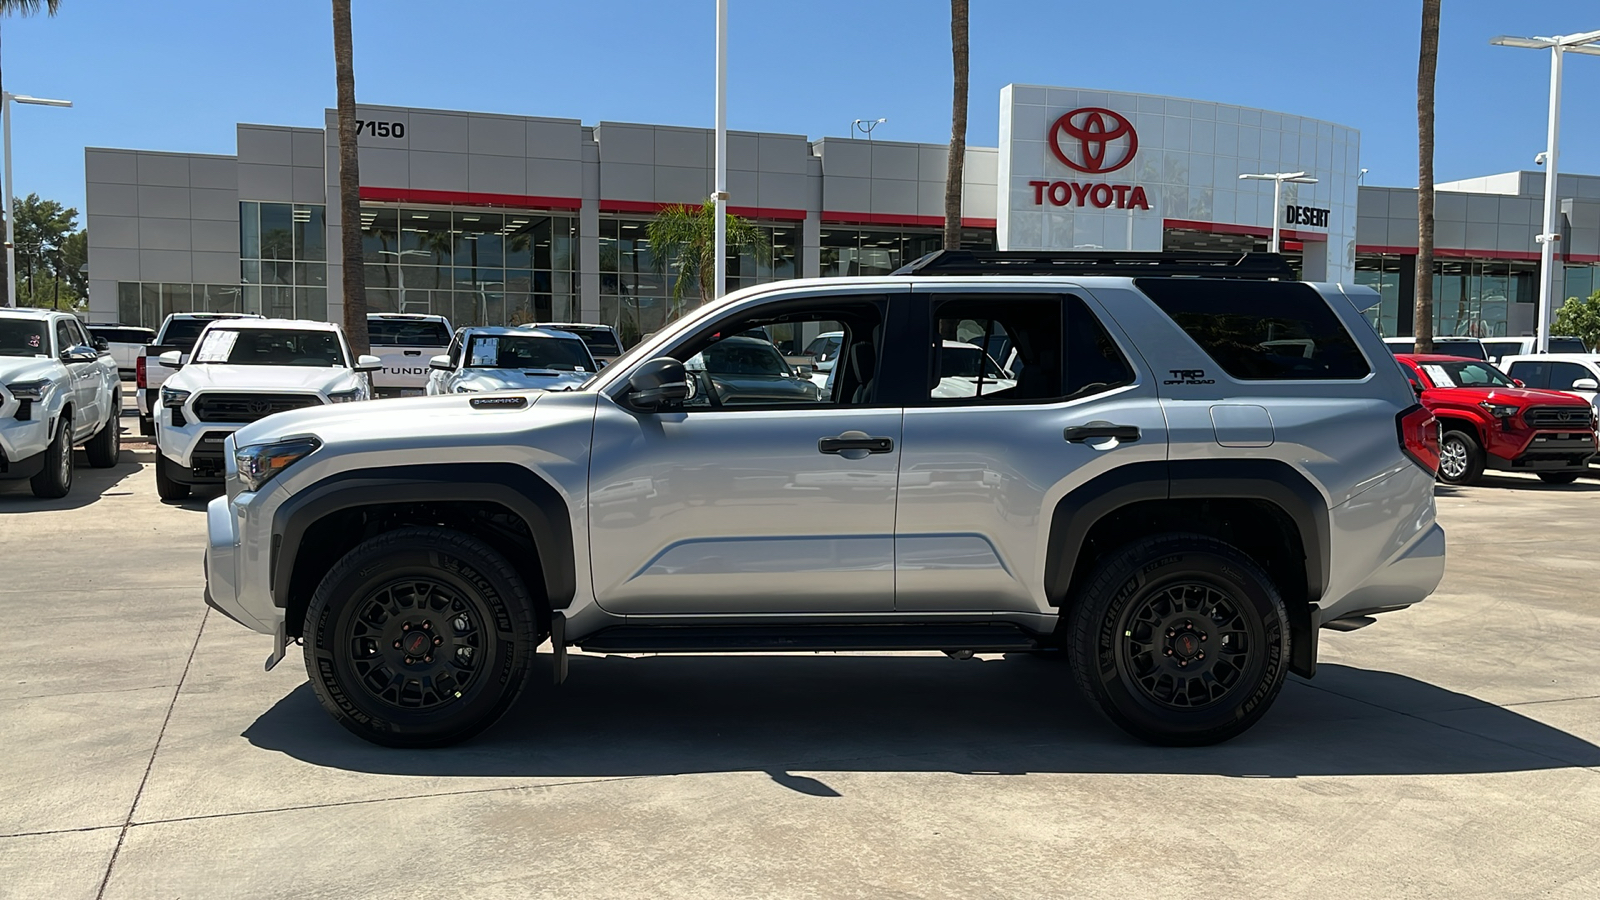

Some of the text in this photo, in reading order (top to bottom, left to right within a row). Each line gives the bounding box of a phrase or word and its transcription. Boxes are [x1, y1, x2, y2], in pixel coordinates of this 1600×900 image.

[355, 120, 405, 138] 7150
[1029, 181, 1150, 210] TOYOTA
[1286, 205, 1330, 228] DESERT
[382, 367, 429, 375] TUND
[1169, 370, 1205, 380] TRD
[460, 566, 510, 629] MICHELIN
[1101, 578, 1136, 648] MICHELIN
[320, 661, 370, 724] MICHELIN
[1245, 645, 1280, 713] MICHELIN
